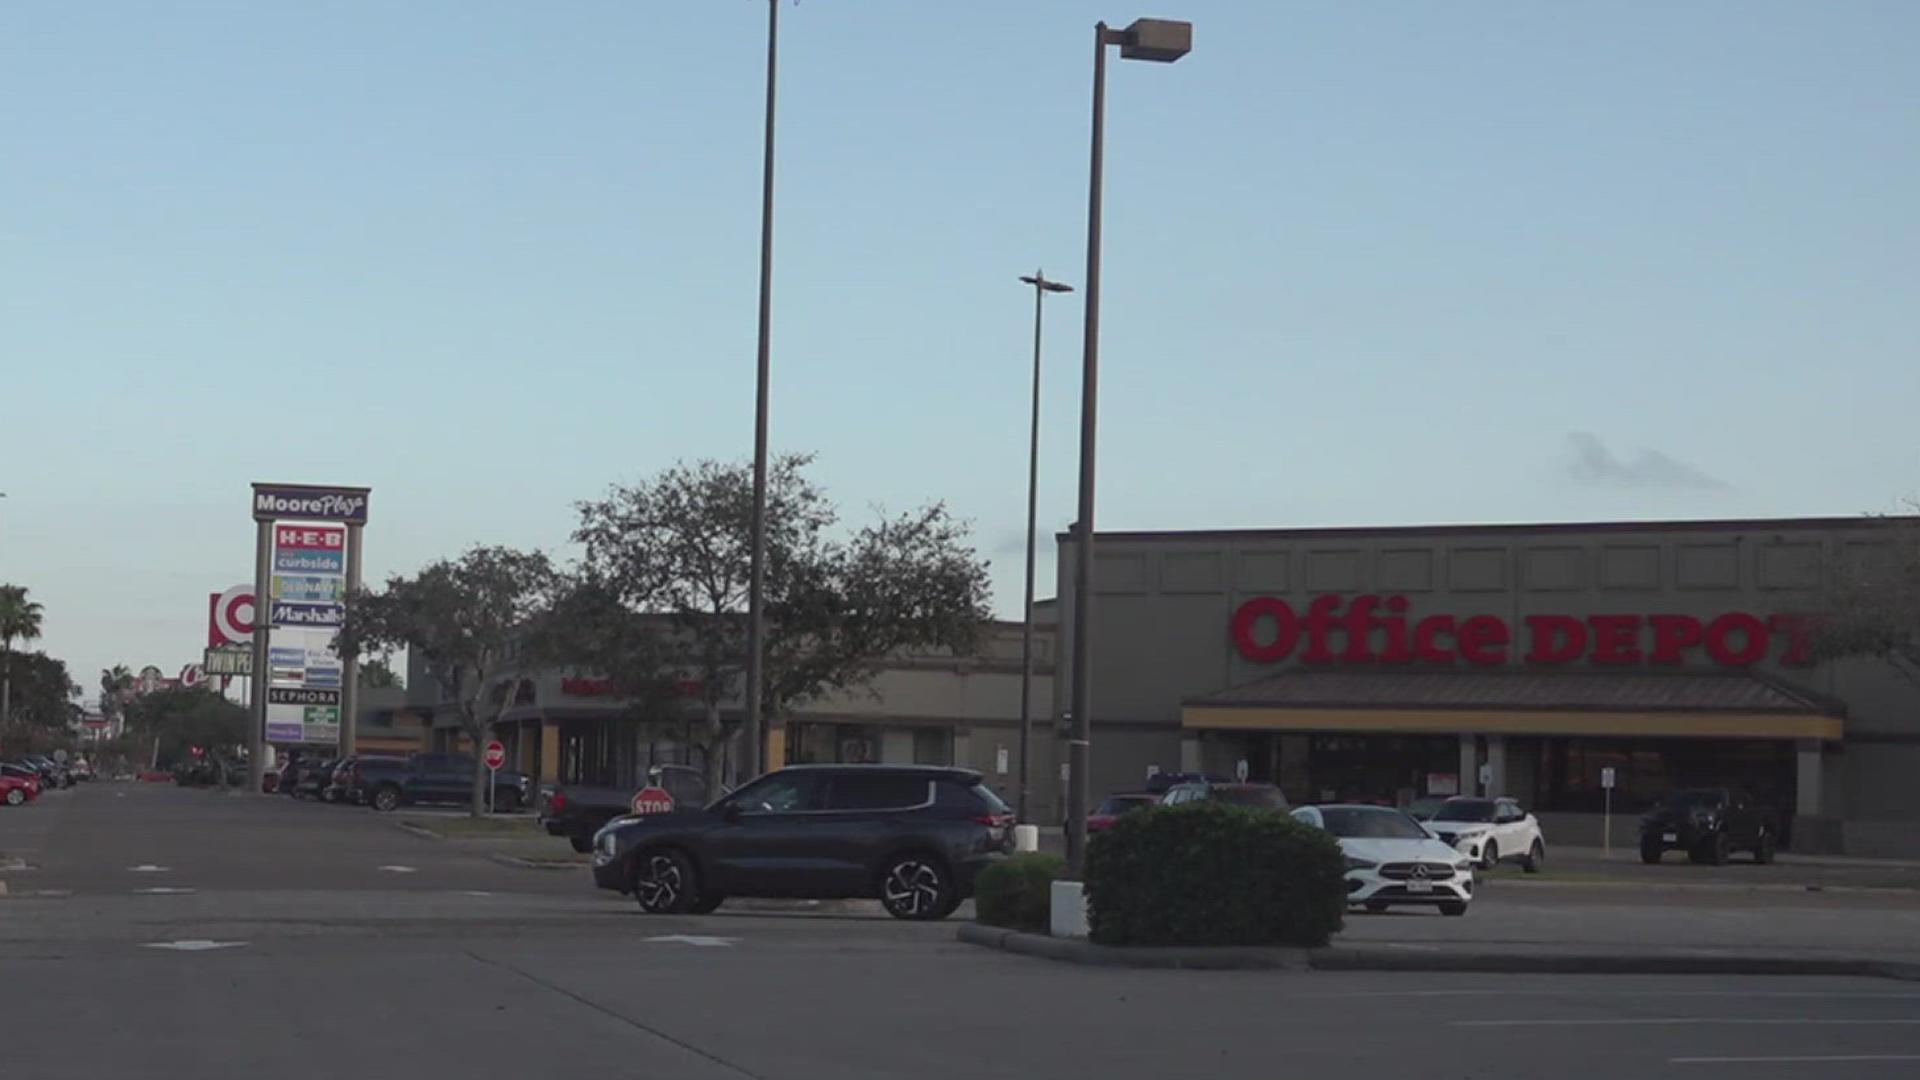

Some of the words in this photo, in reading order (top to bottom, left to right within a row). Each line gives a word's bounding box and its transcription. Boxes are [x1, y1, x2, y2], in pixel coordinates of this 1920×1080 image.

[256, 494, 321, 512] Moore
[319, 494, 364, 516] Plaza
[278, 556, 339, 570] curbside
[1231, 594, 1510, 665] Office
[1525, 611, 1824, 667] DEPOT
[271, 690, 336, 703] SEPHORA
[635, 799, 671, 814] STOP
